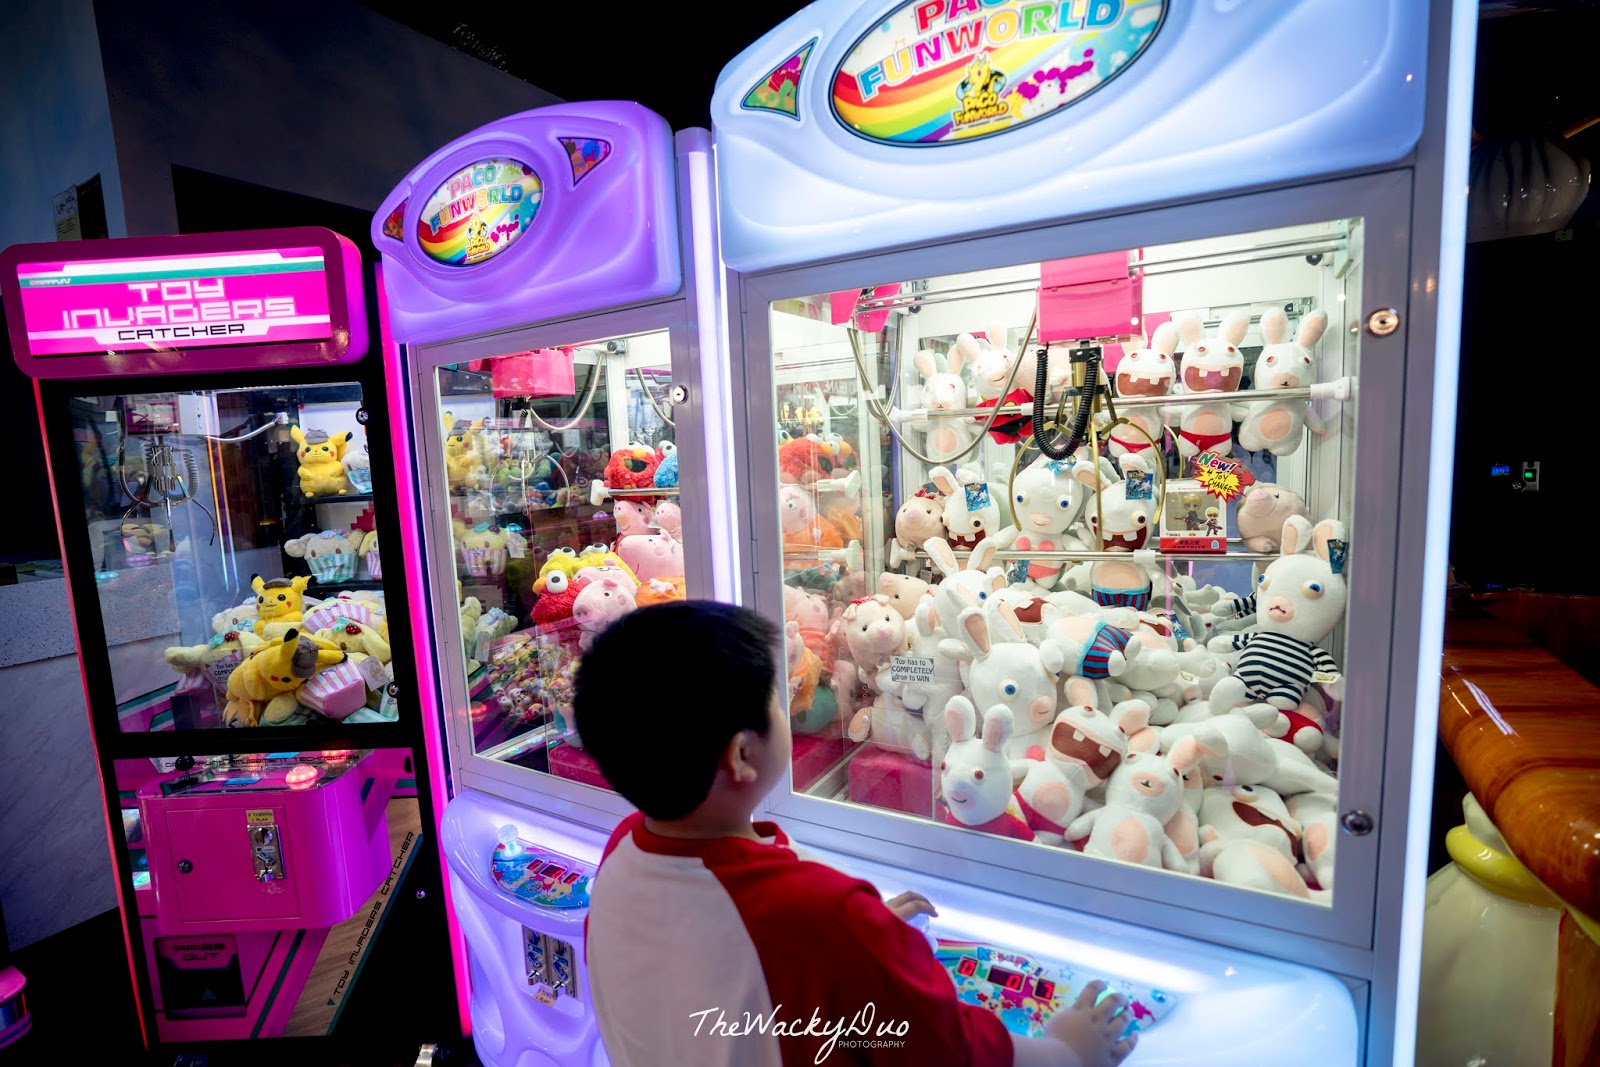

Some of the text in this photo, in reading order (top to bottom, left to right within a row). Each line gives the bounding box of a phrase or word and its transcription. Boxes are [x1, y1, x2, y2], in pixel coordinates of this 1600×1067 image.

[915, 0, 1006, 34] PA
[857, 0, 1125, 102] FUNWORLD
[451, 164, 496, 197] PACO
[430, 184, 522, 235] FUNWORLD
[128, 278, 225, 302] TOY
[62, 297, 296, 329] INVADERS
[118, 324, 245, 341] CATCHER
[1198, 453, 1236, 473] New!
[892, 666, 934, 675] COMPLETELY
[333, 831, 415, 995] TOY INVADERS CATCHER
[183, 953, 219, 961] OUT
[961, 960, 976, 977] 0
[1005, 974, 1021, 990] 0
